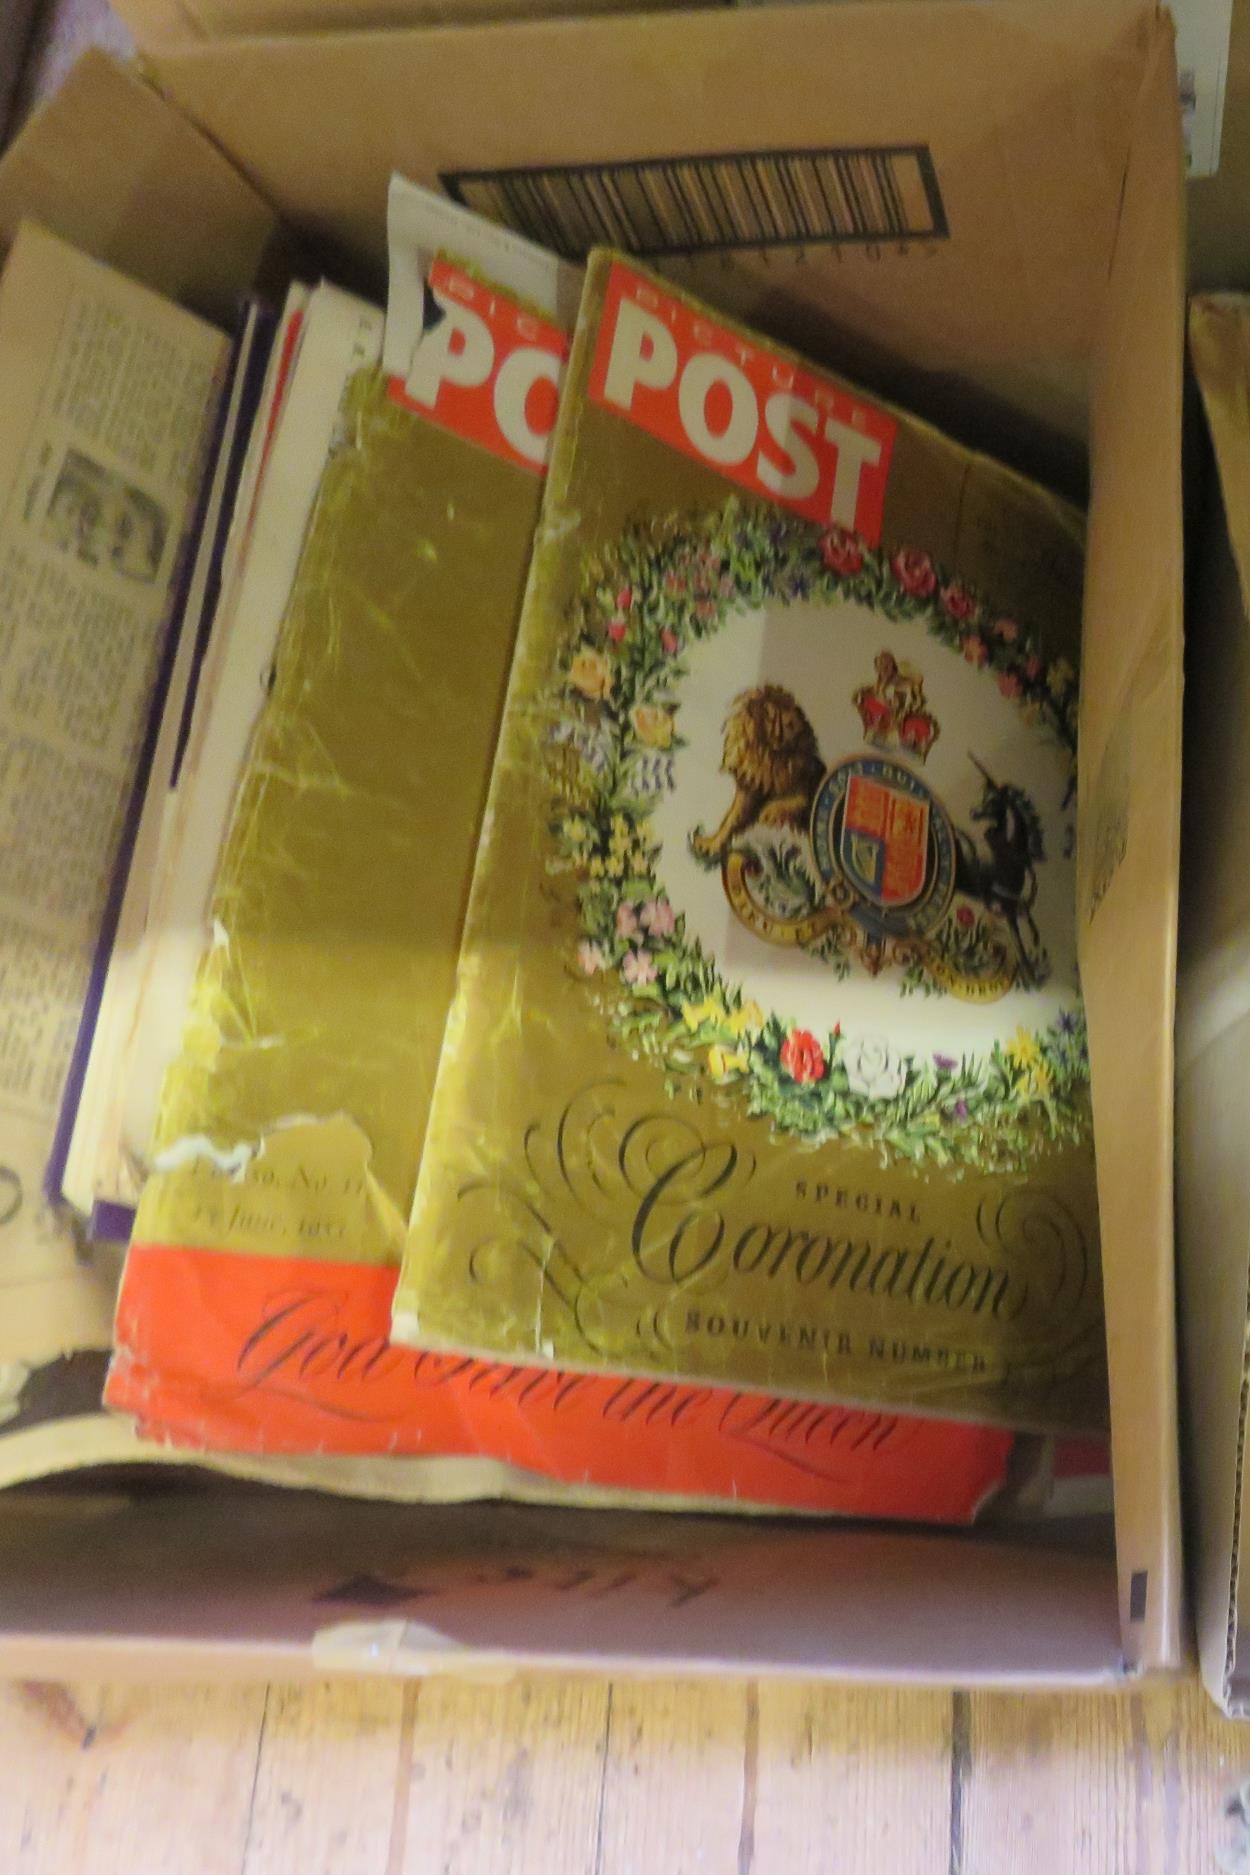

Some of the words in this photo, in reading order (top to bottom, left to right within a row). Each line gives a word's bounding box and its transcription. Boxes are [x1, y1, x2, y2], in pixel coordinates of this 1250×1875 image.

[403, 294, 562, 464] PO
[604, 297, 883, 533] POST
[618, 1113, 1028, 1322] Coronation
[794, 1178, 922, 1226] SPECIAL
[684, 1309, 853, 1358] SOUVENIR
[868, 1333, 989, 1374] NUMBER
